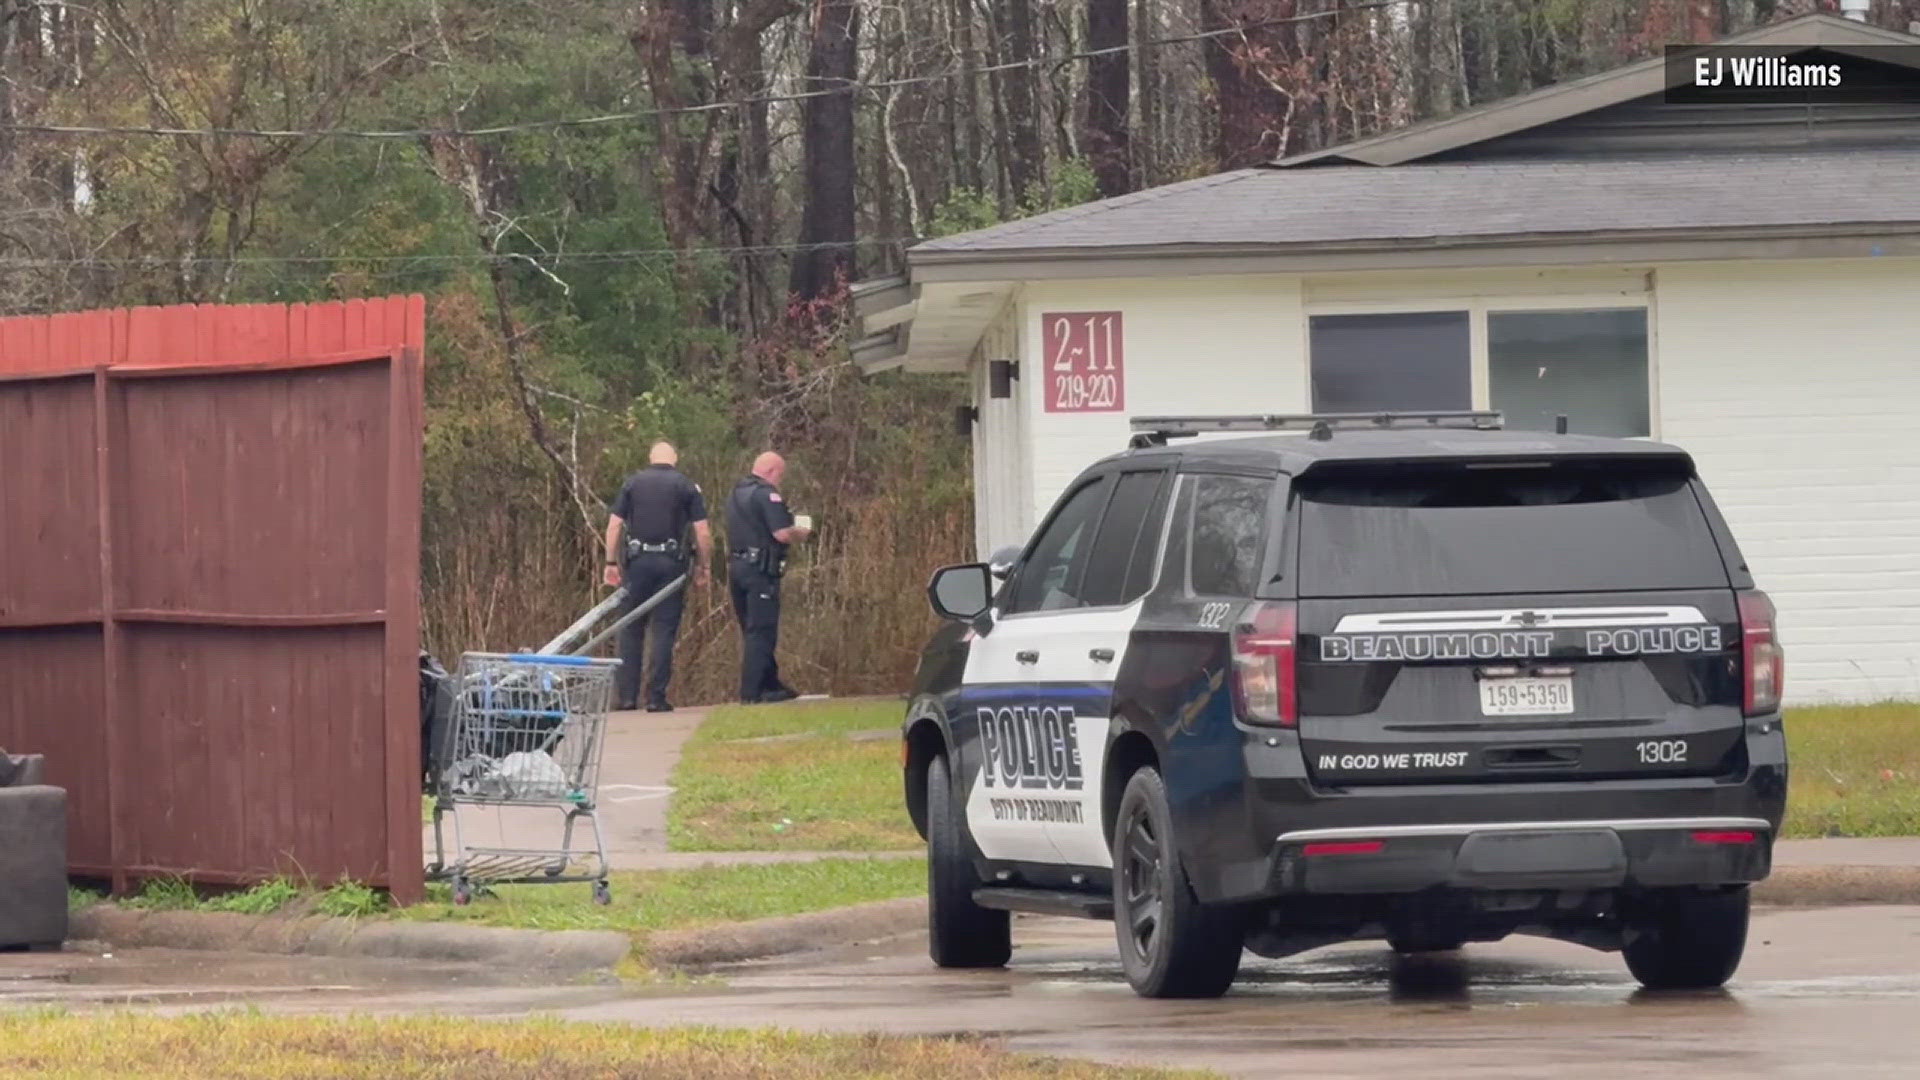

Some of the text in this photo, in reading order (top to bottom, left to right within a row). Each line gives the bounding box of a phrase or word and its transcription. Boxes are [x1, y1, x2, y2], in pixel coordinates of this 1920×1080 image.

[1056, 373, 1117, 408] 219-220
[1198, 602, 1230, 628] 1302
[1320, 626, 1722, 662] BEAUMONT POLICE
[977, 705, 1083, 790] POLICE
[1318, 752, 1468, 769] IN GOD WE TRUST
[1636, 740, 1687, 763] 1302
[990, 798, 1083, 824] CITY OF BEAUMONT
